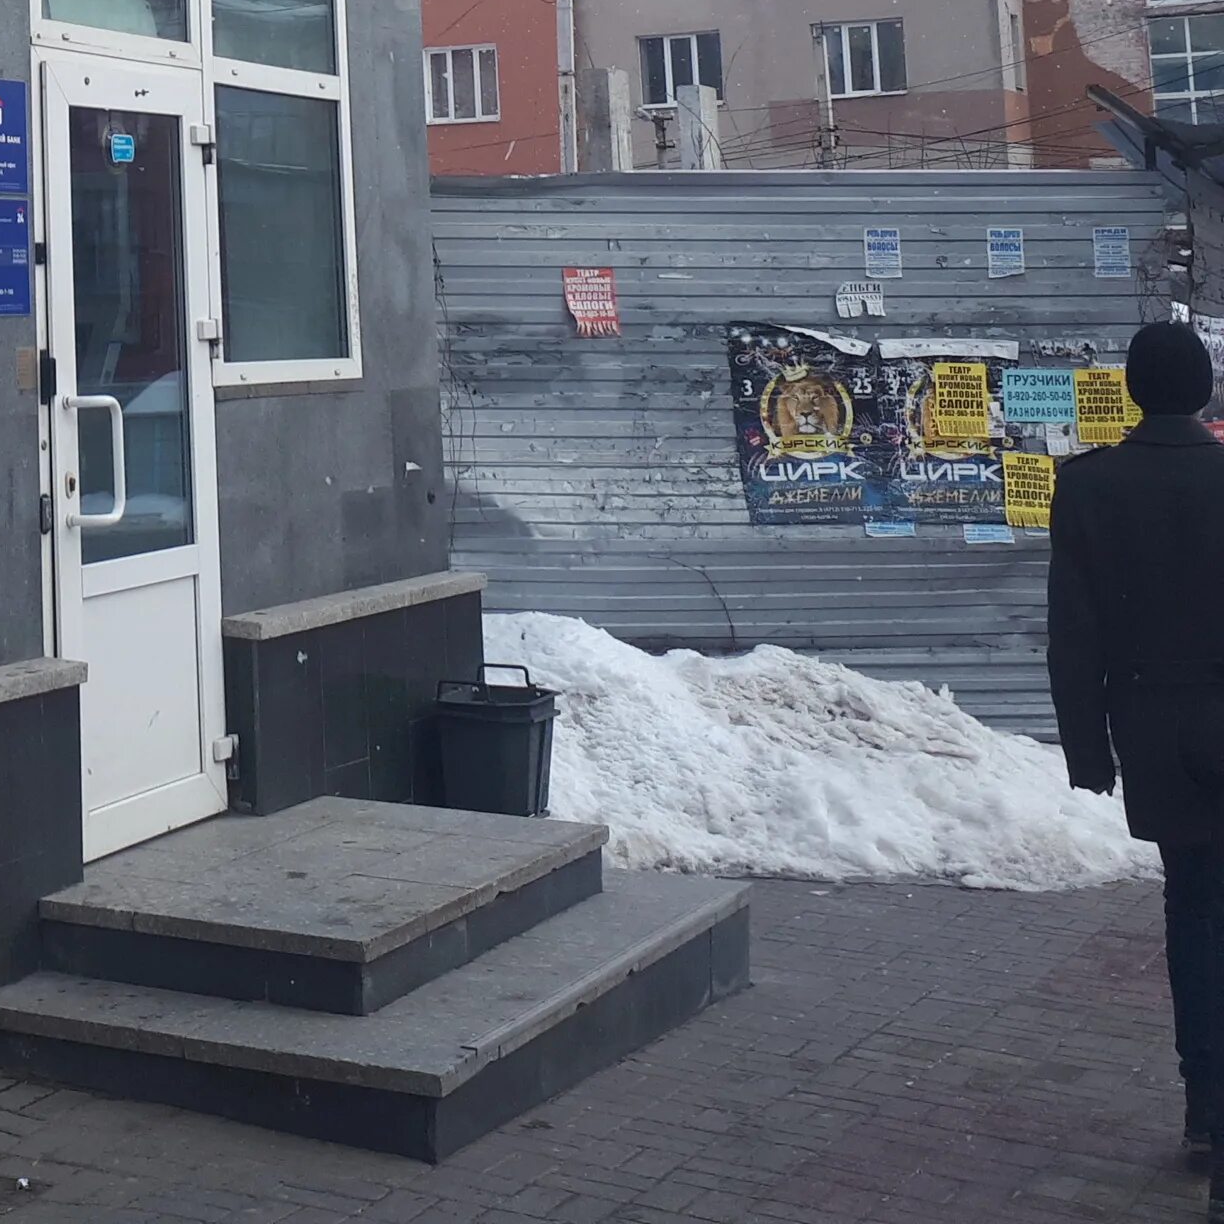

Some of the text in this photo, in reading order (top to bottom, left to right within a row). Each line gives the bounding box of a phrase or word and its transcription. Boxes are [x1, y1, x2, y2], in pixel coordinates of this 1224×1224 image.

[569, 300, 613, 310] САПОГИ
[949, 366, 971, 374] ТЕАТР
[1007, 374, 1070, 386] ГРУЗЧИКИ
[1088, 372, 1111, 380] ТЕАТР
[741, 379, 753, 396] 3
[853, 377, 873, 394] 25
[938, 381, 982, 390] ХРОМОВЫЕ
[1078, 388, 1122, 396] ХРОМОВЫЕ
[939, 399, 984, 409] САПОГИ
[1008, 407, 1074, 417] РАЗНОРАБОЧИЕ
[1078, 405, 1124, 415] САПОГИ
[771, 438, 851, 450] КУРСКИЙ
[913, 440, 991, 451] КУРСКИЙ
[1017, 457, 1039, 465] ТЕАТР
[759, 462, 866, 482] ЦИРК
[900, 461, 1002, 482] ЦИРК
[1007, 472, 1050, 482] ХРОМОВЫЕ
[1007, 489, 1051, 501] САПОГИ
